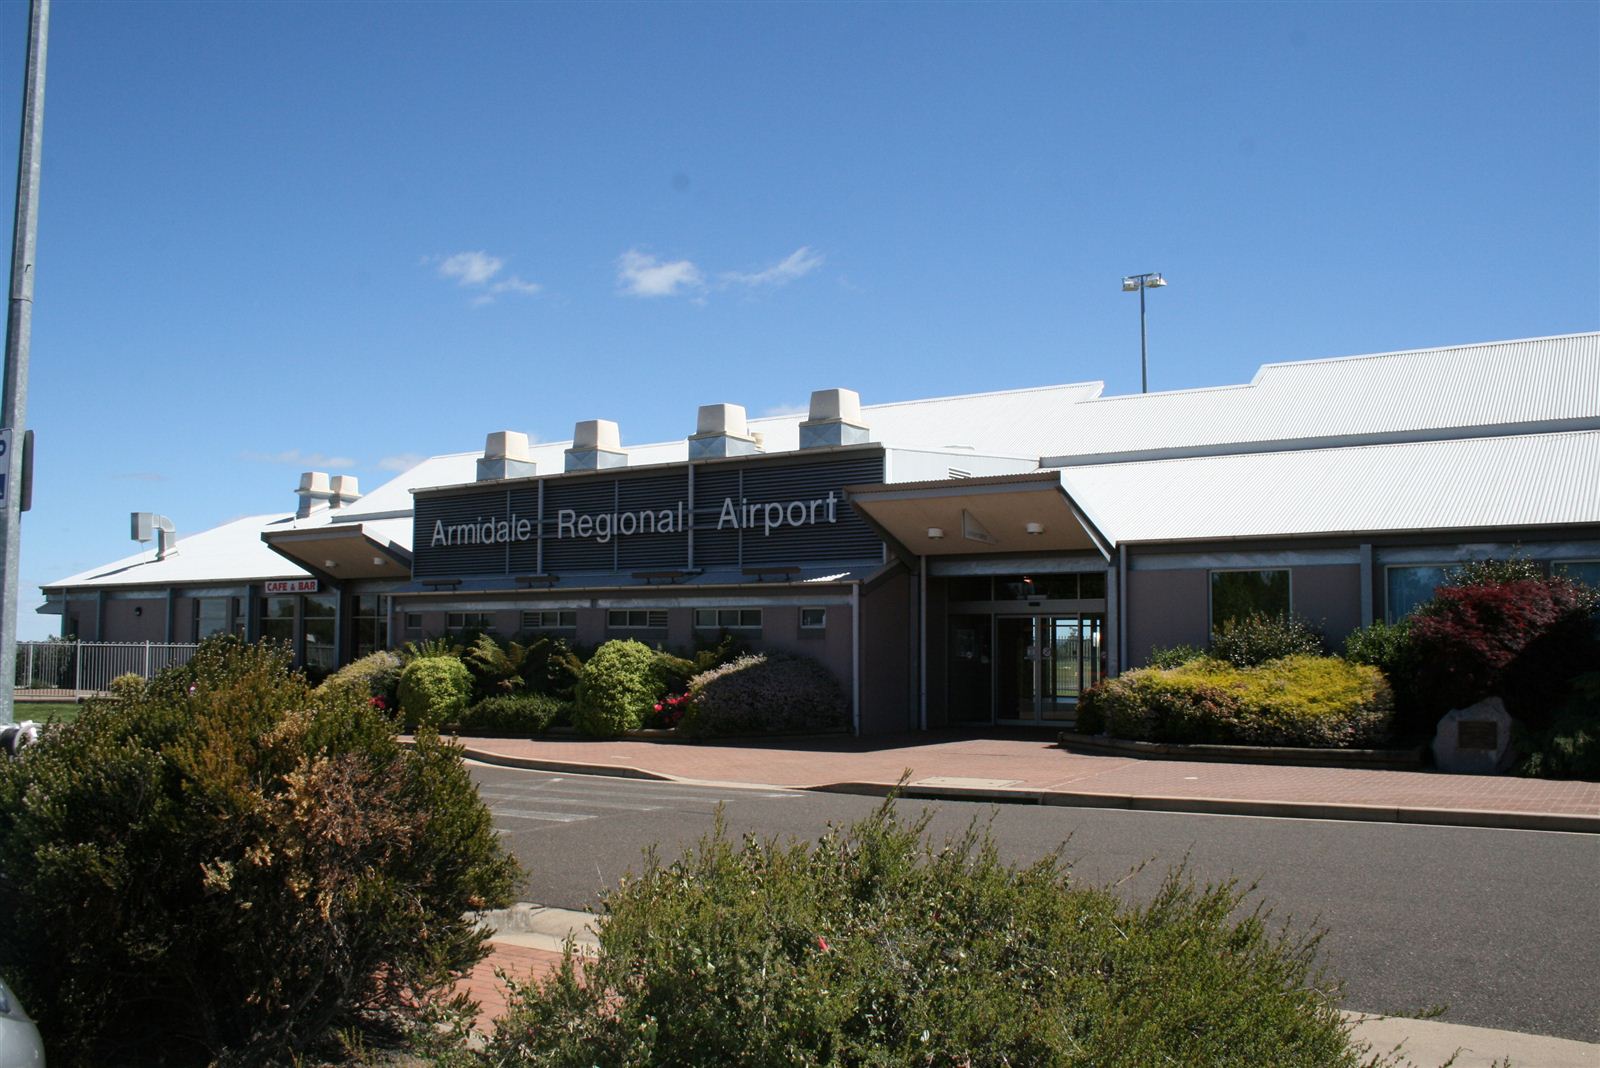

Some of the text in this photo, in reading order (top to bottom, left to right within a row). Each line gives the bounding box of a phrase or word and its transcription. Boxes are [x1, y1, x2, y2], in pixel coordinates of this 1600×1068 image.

[431, 491, 838, 547] Armidale Regional Airport
[267, 581, 316, 592] CAFE & BAR
